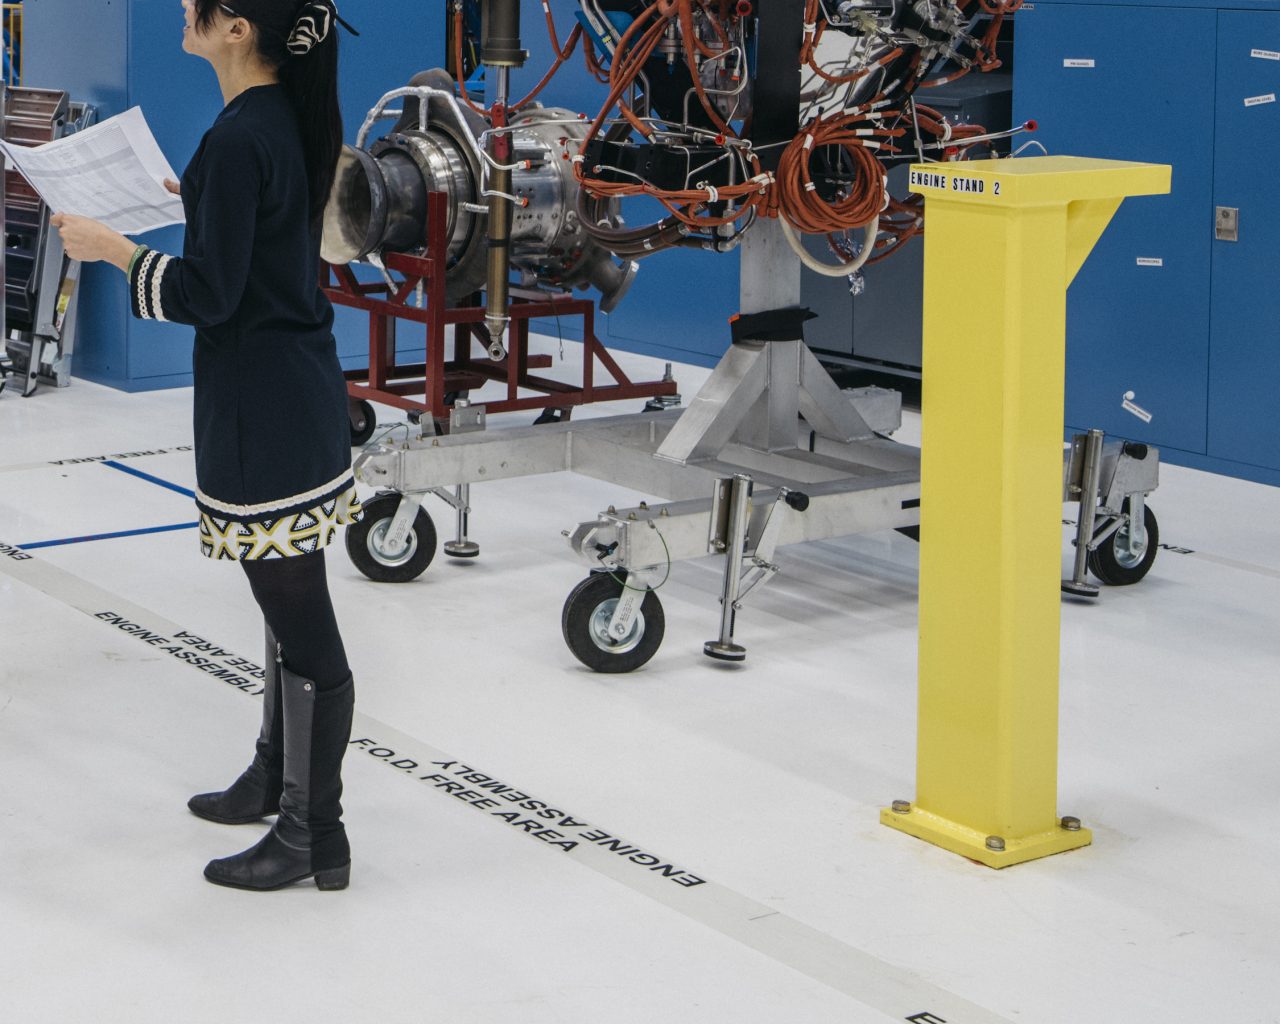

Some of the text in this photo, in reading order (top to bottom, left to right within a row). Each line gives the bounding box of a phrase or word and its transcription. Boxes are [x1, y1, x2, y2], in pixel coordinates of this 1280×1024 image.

[911, 171, 1000, 195] ENGINE STAND 2
[94, 610, 171, 646] ENGINE
[172, 630, 235, 657] AREA
[349, 737, 580, 853] F.O.D. FREE AREA
[430, 760, 708, 888] ENGINE ASSEMBLY
